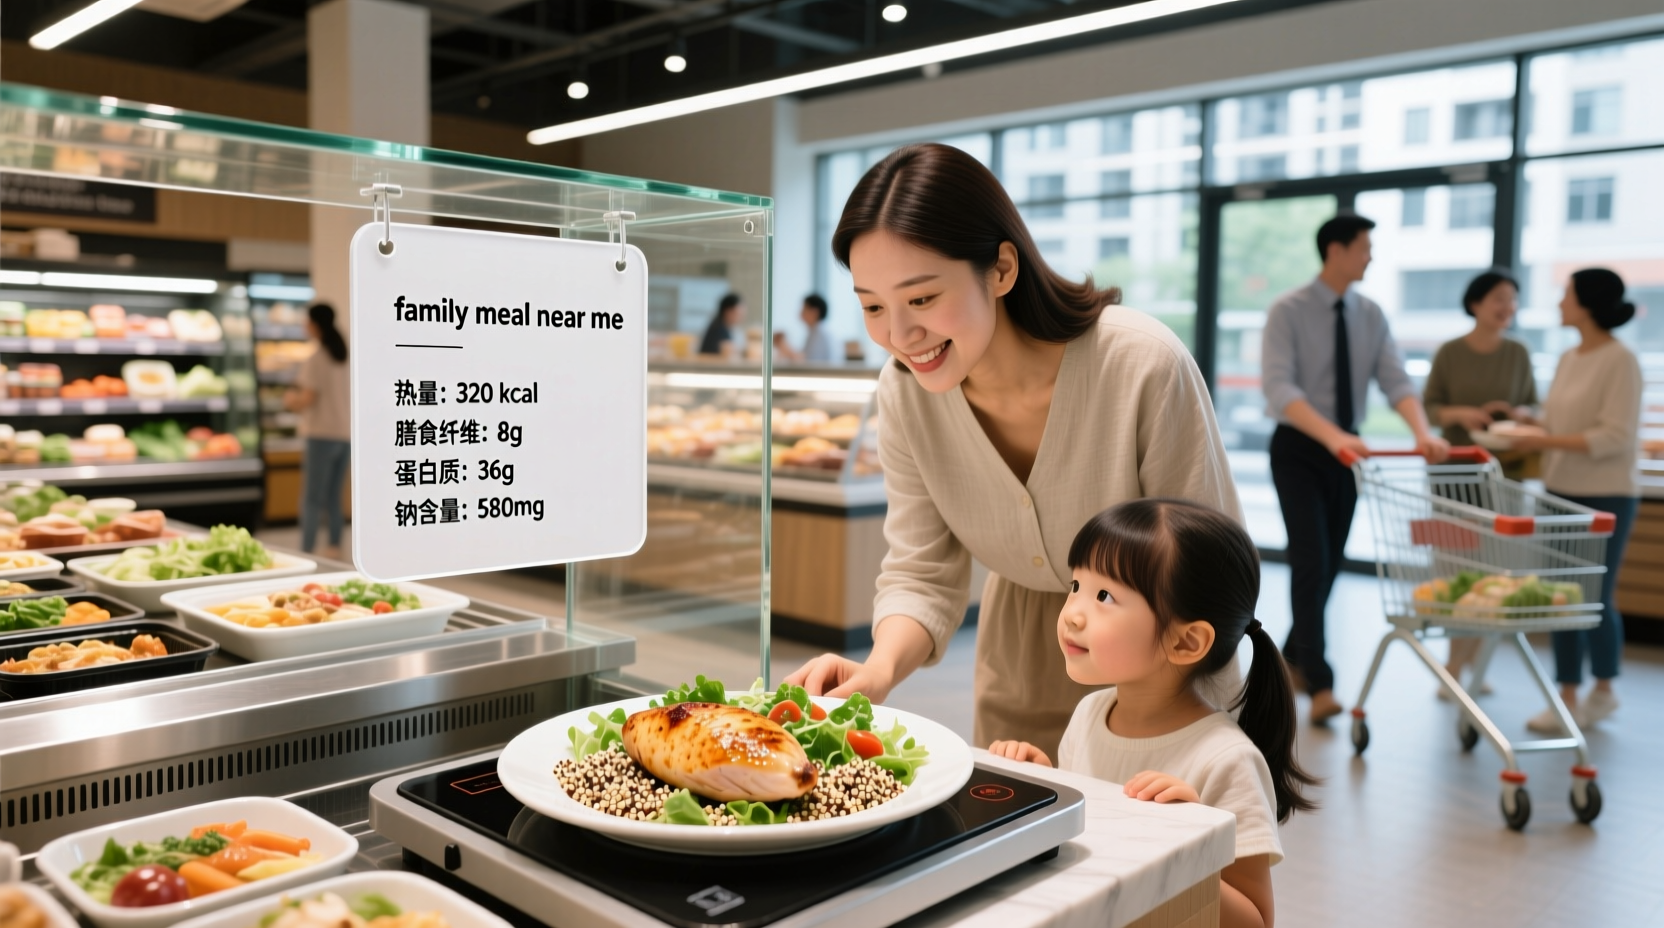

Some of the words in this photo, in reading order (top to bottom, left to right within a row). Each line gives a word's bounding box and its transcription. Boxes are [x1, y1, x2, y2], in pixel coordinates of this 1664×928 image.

[394, 296, 469, 330] family
[476, 302, 530, 327] meal
[537, 309, 586, 329] near
[591, 311, 624, 330] me
[456, 381, 493, 404] 320
[499, 381, 538, 404] kcal
[497, 420, 523, 447] 8g
[477, 459, 515, 486] 36g
[477, 496, 545, 521] 580mg
